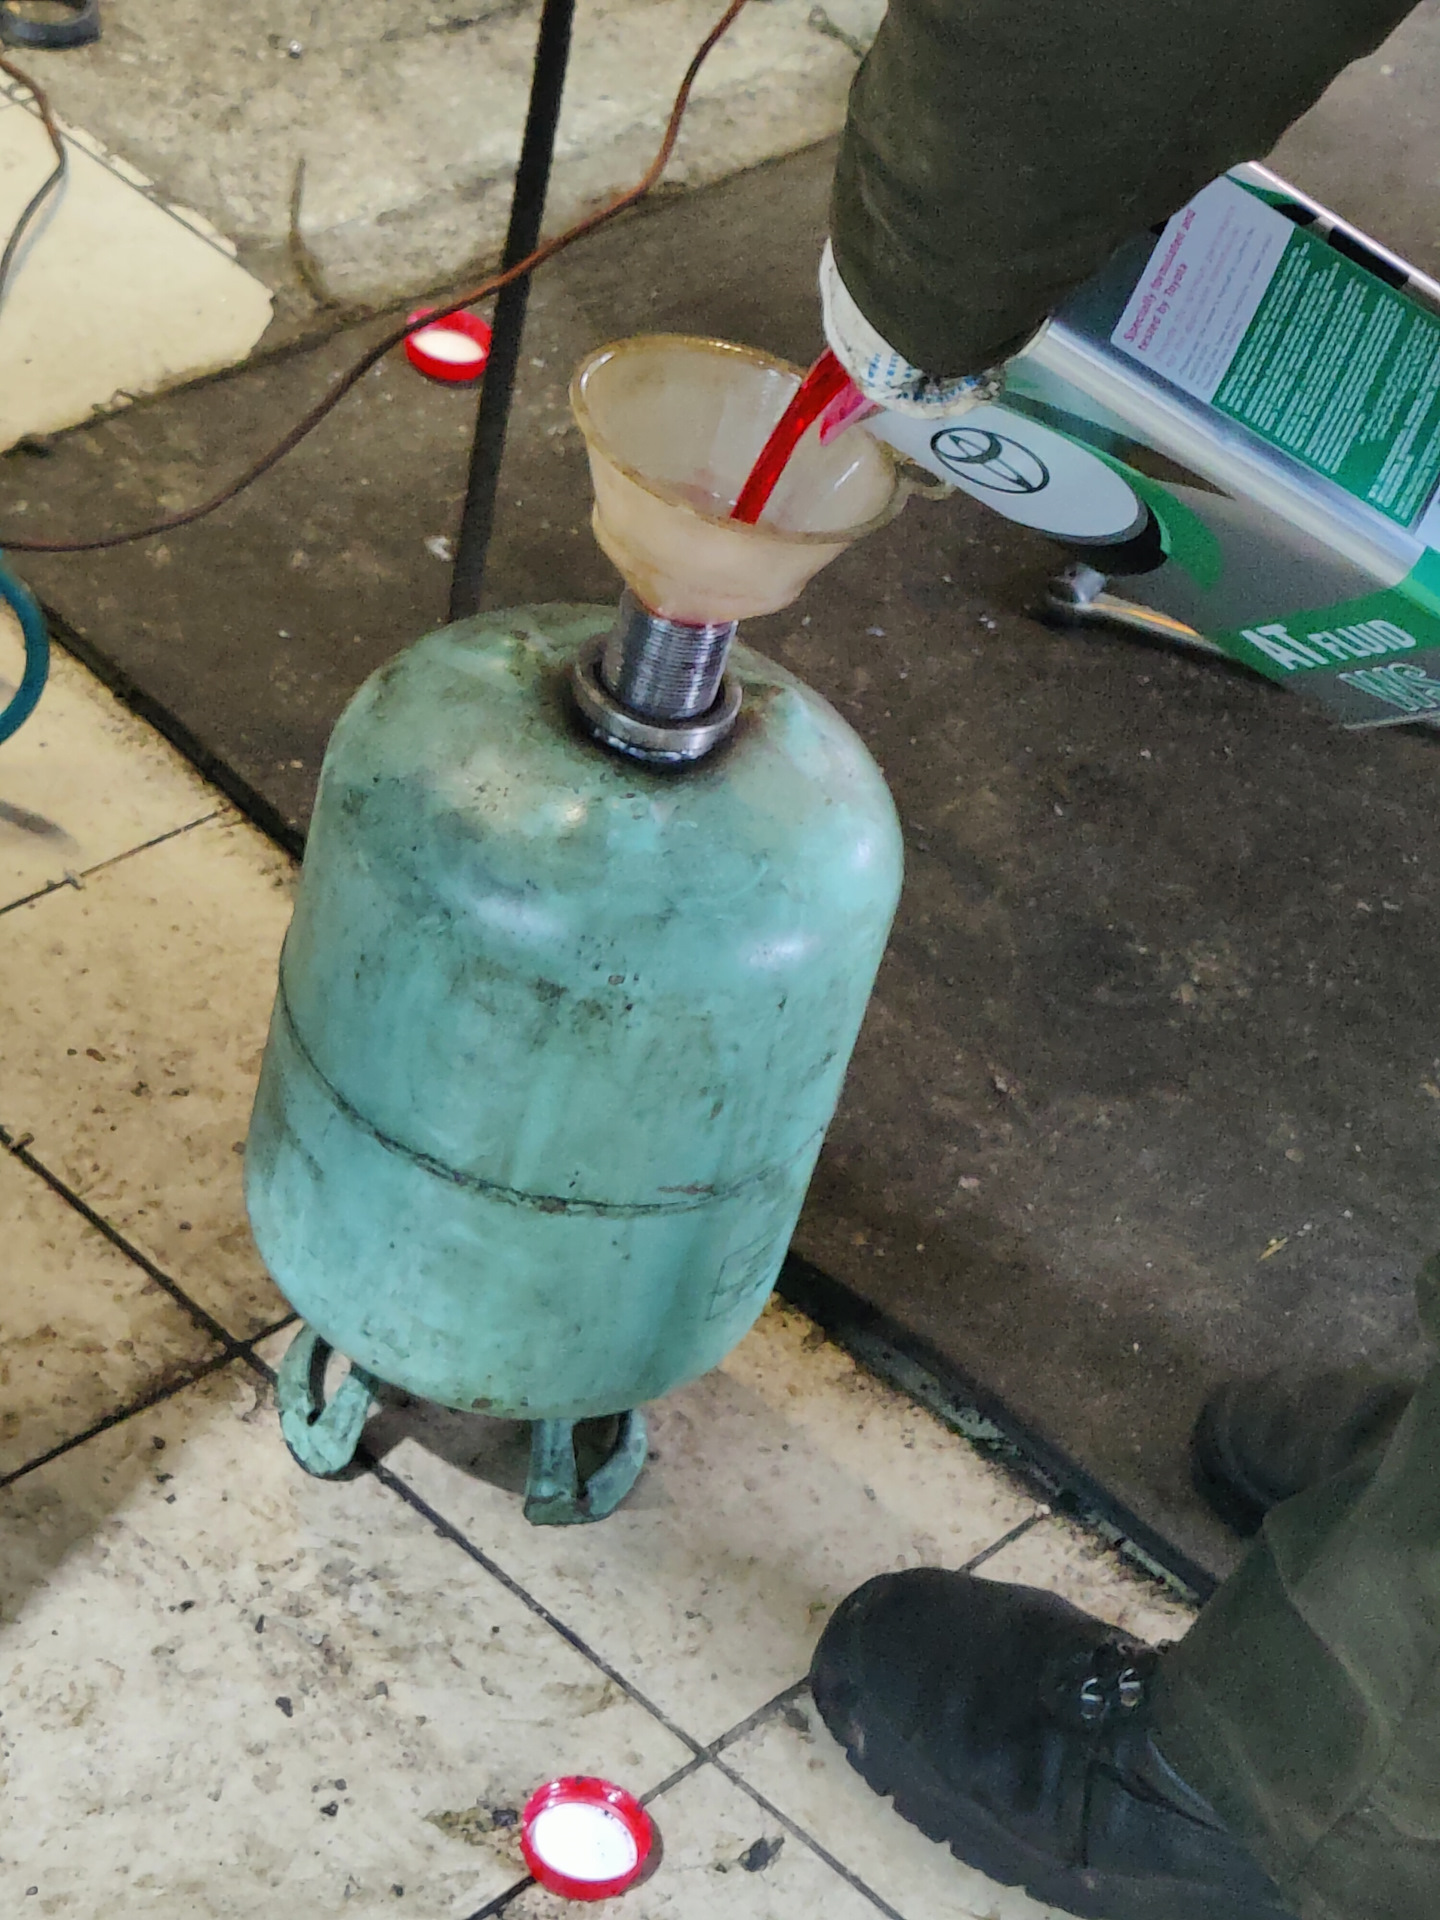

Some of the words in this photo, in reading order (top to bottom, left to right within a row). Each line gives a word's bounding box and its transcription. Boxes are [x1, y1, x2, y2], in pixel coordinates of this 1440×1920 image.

[1124, 294, 1157, 342] Specially
[1151, 231, 1186, 291] formulated
[1182, 208, 1196, 231] and
[1138, 315, 1161, 351] tested
[1156, 300, 1171, 315] by
[1164, 263, 1188, 297] Toyota
[1240, 623, 1329, 671] AT
[1306, 619, 1416, 660] FLUID
